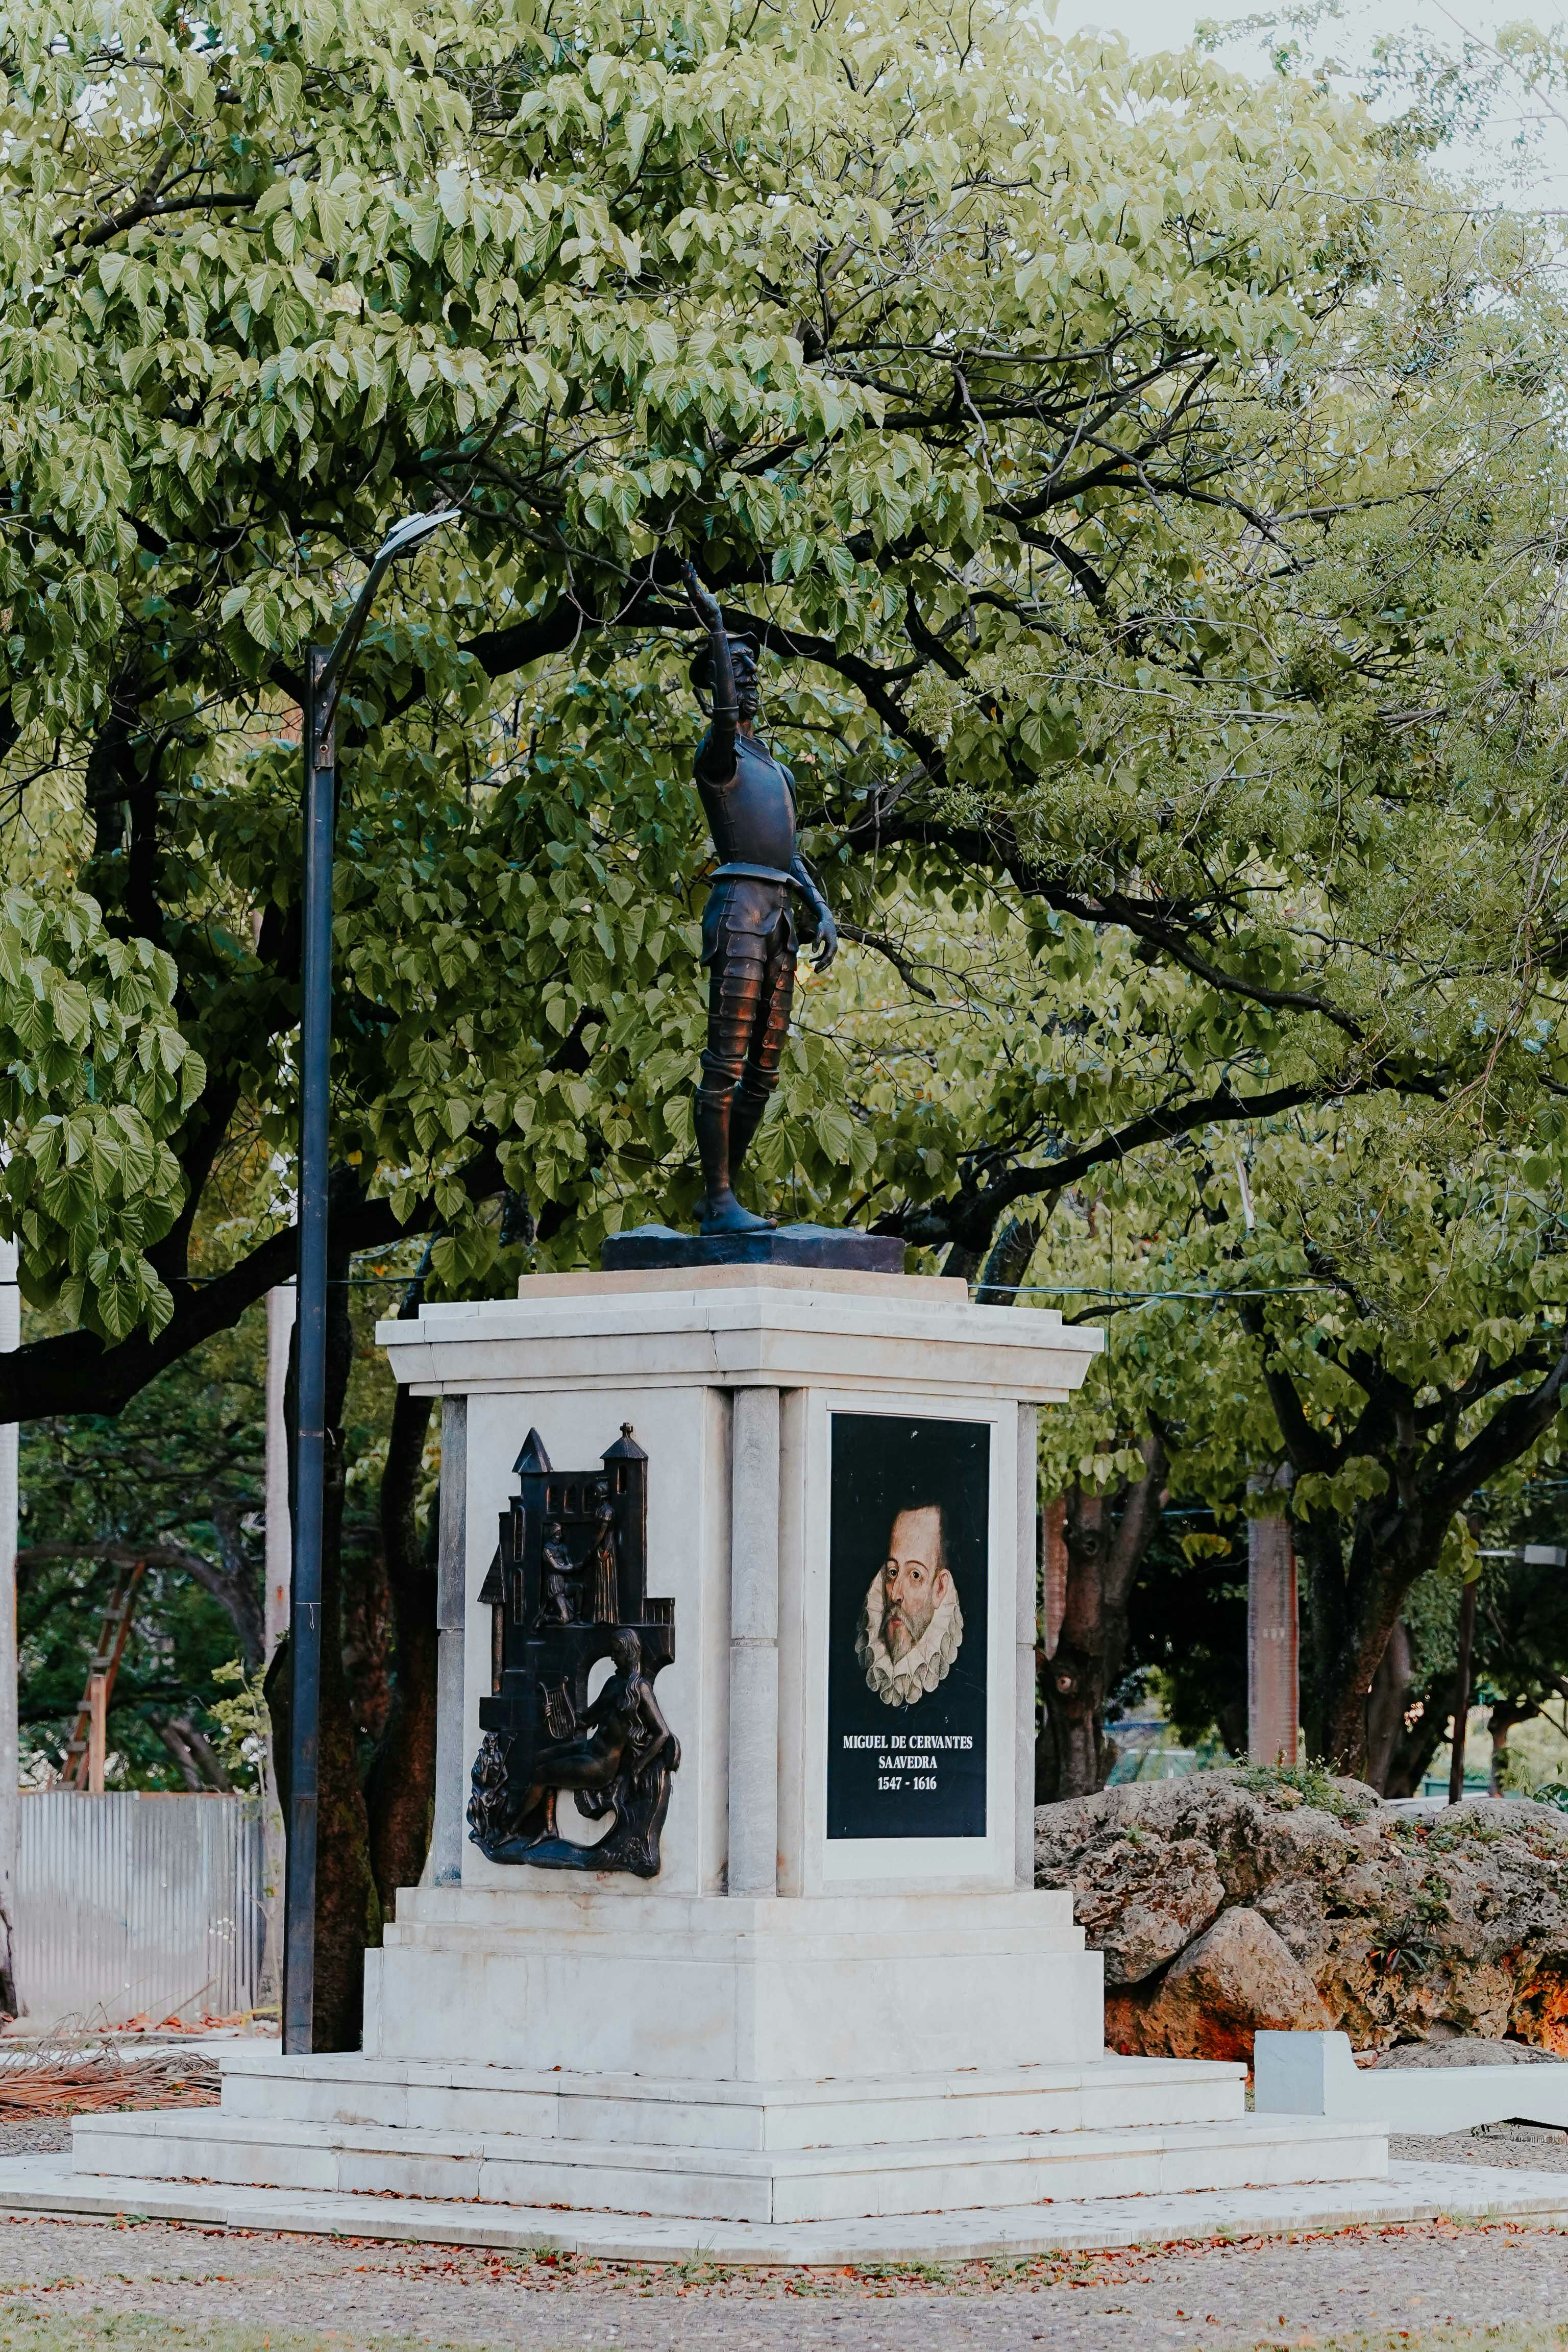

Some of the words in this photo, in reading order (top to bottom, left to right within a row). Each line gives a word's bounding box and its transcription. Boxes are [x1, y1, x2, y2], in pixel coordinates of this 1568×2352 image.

[843, 1735, 888, 1749] MIGUEL
[891, 1735, 906, 1749] DE
[909, 1735, 973, 1749] CERVANTES
[878, 1755, 938, 1769] SAAVEDRA
[877, 1776, 902, 1790] 1547
[913, 1776, 937, 1790] 1616
